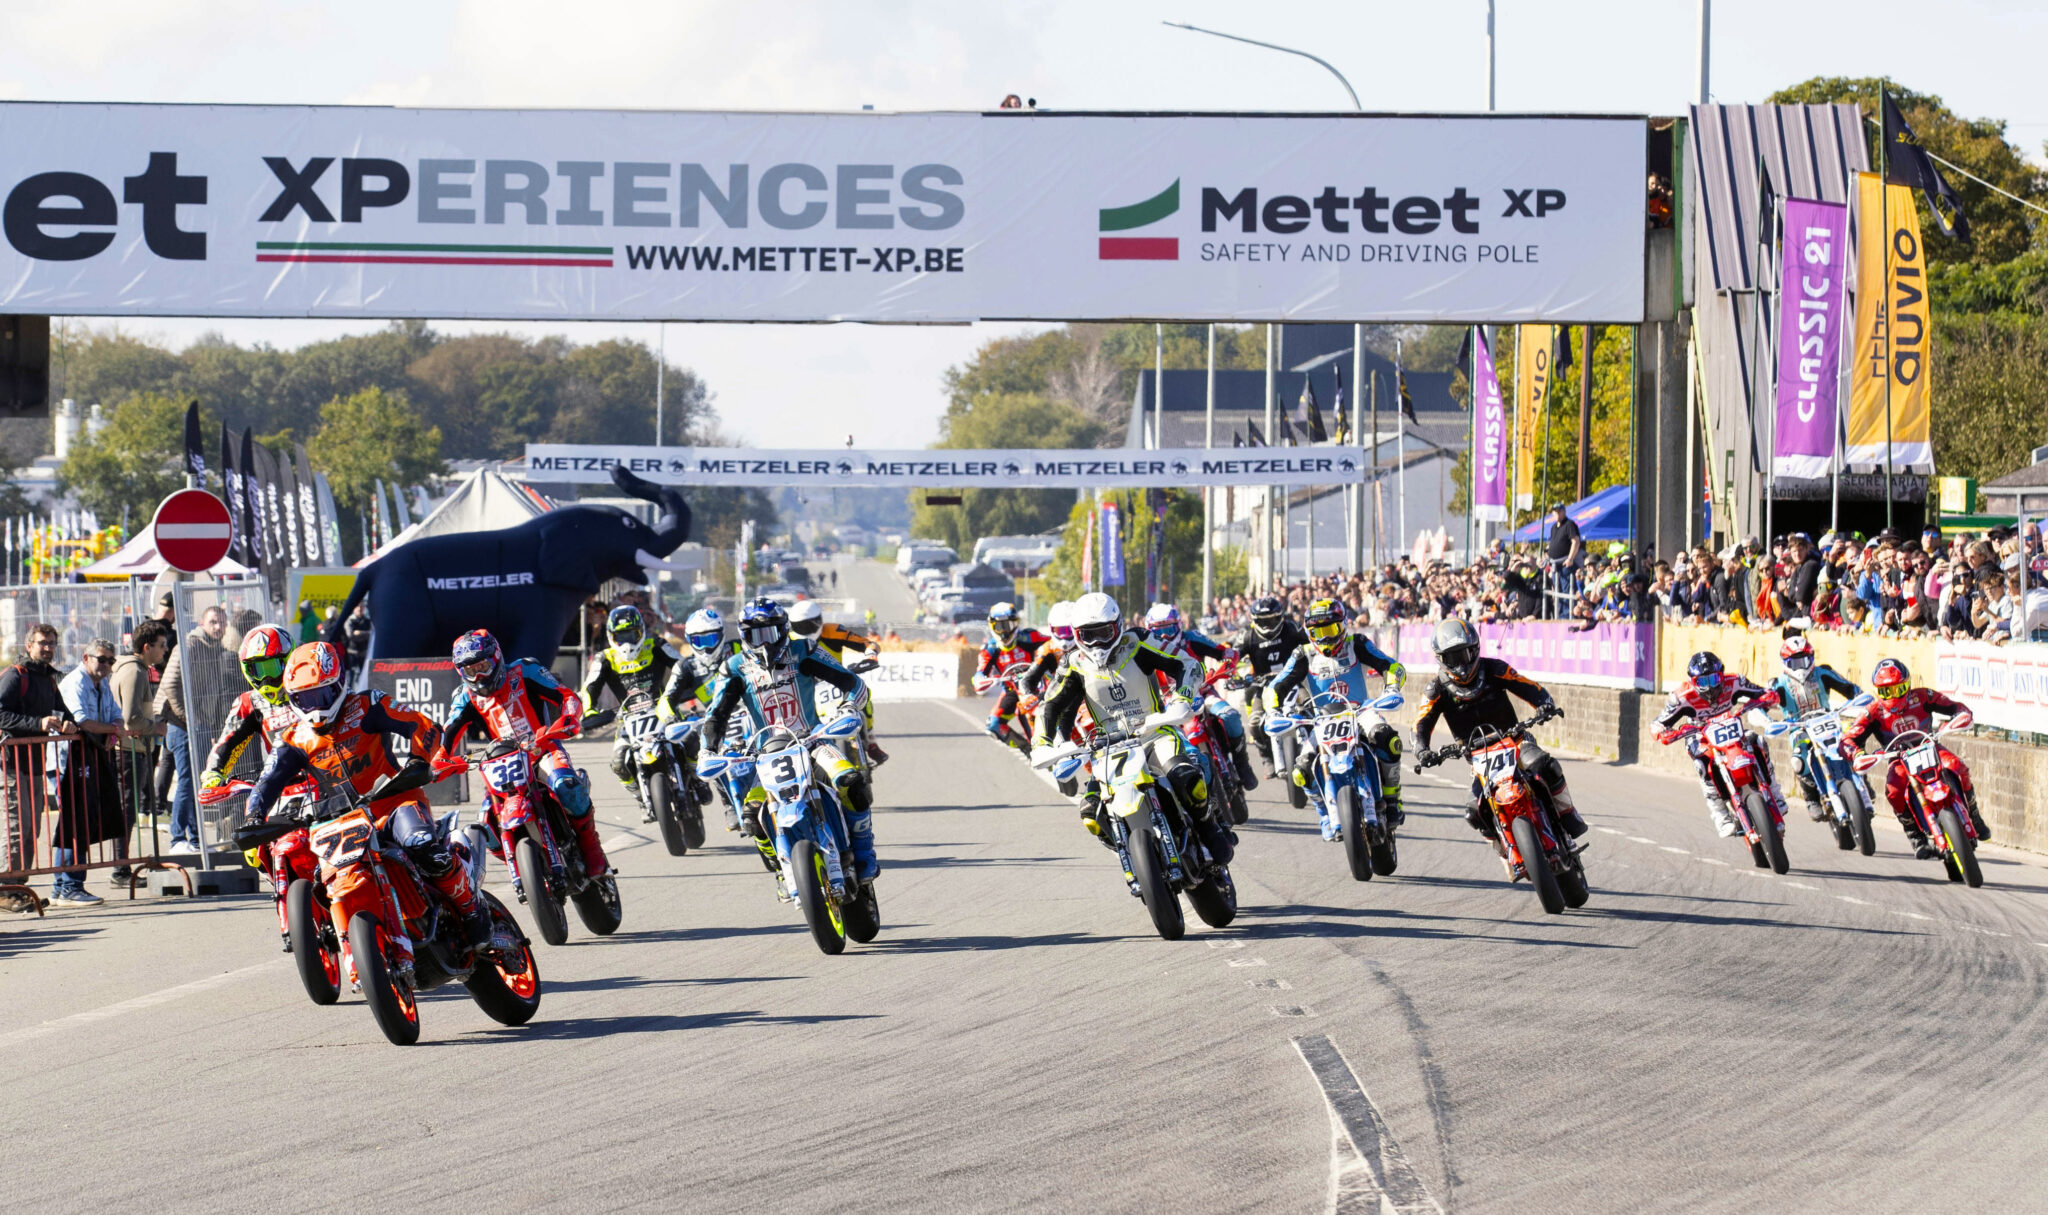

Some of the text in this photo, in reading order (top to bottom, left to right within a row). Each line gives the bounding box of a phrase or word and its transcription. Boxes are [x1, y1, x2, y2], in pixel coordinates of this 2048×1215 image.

[257, 156, 965, 230] XPERIENCES
[1201, 187, 1566, 234] Mettet XP
[626, 245, 964, 273] WWW.METTET-XP.BE
[1201, 243, 1539, 263] SAFETY AND DRIVING POLE
[1797, 227, 1831, 423] CLASSIC 21
[1484, 380, 1501, 483] CLASSIC
[700, 459, 829, 474] METZELER
[867, 461, 997, 475] METZELER
[1035, 461, 1165, 475] METZELER
[1202, 459, 1332, 474] METZELER
[427, 572, 534, 590] METZELER
[373, 660, 455, 675] Supermoto
[396, 678, 432, 703] END
[631, 715, 659, 737] 177
[1323, 720, 1351, 740] 96
[1714, 723, 1740, 745] 62
[1812, 720, 1837, 736] 95
[493, 759, 524, 787] 32
[771, 755, 796, 784] 3
[1111, 751, 1129, 777] 7
[1481, 749, 1515, 777] 741
[316, 824, 370, 860] 72
